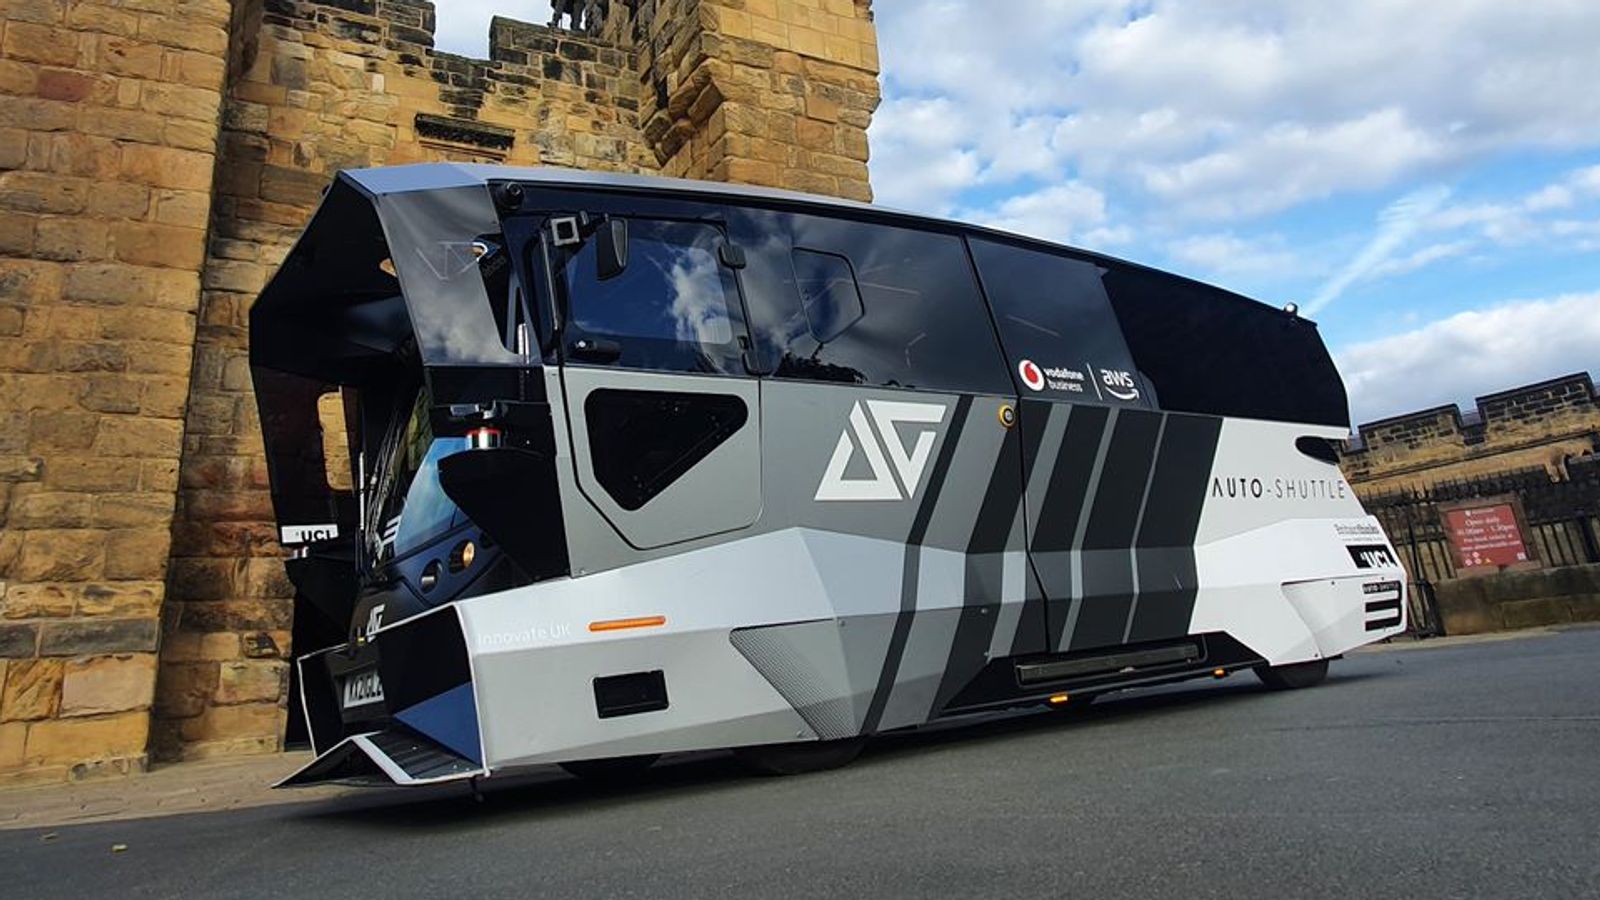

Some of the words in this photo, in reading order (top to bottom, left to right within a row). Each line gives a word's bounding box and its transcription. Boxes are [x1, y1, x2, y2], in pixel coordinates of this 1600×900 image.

[1043, 366, 1085, 382] vodafone
[1100, 368, 1135, 388] aws
[1047, 378, 1083, 393] business
[1212, 477, 1345, 499] AUTO-SHUTTLE
[478, 627, 548, 646] Innovate
[550, 623, 570, 639] UK
